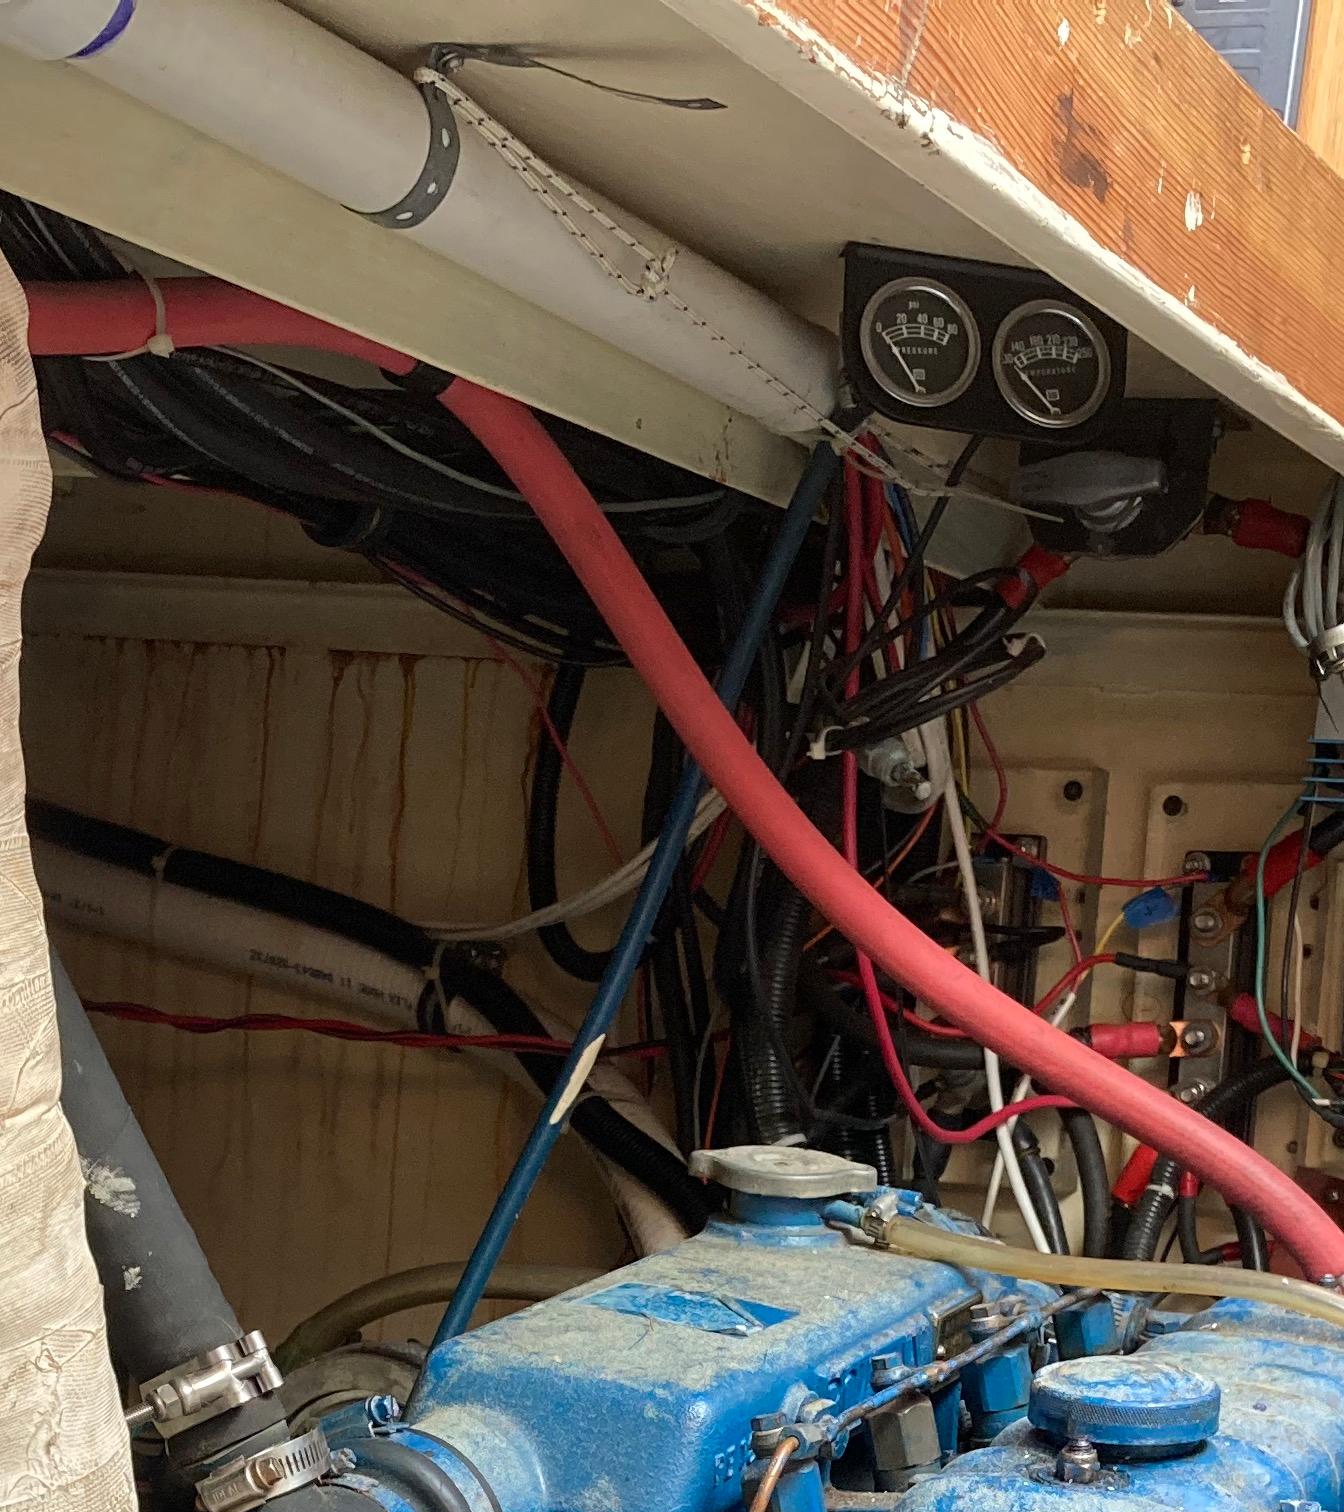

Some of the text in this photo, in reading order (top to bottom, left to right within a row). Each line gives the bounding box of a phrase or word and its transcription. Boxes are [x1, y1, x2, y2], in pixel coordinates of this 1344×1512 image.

[875, 322, 883, 333] 0
[896, 313, 908, 324] 20
[916, 313, 928, 324] 40
[933, 317, 945, 328] 60
